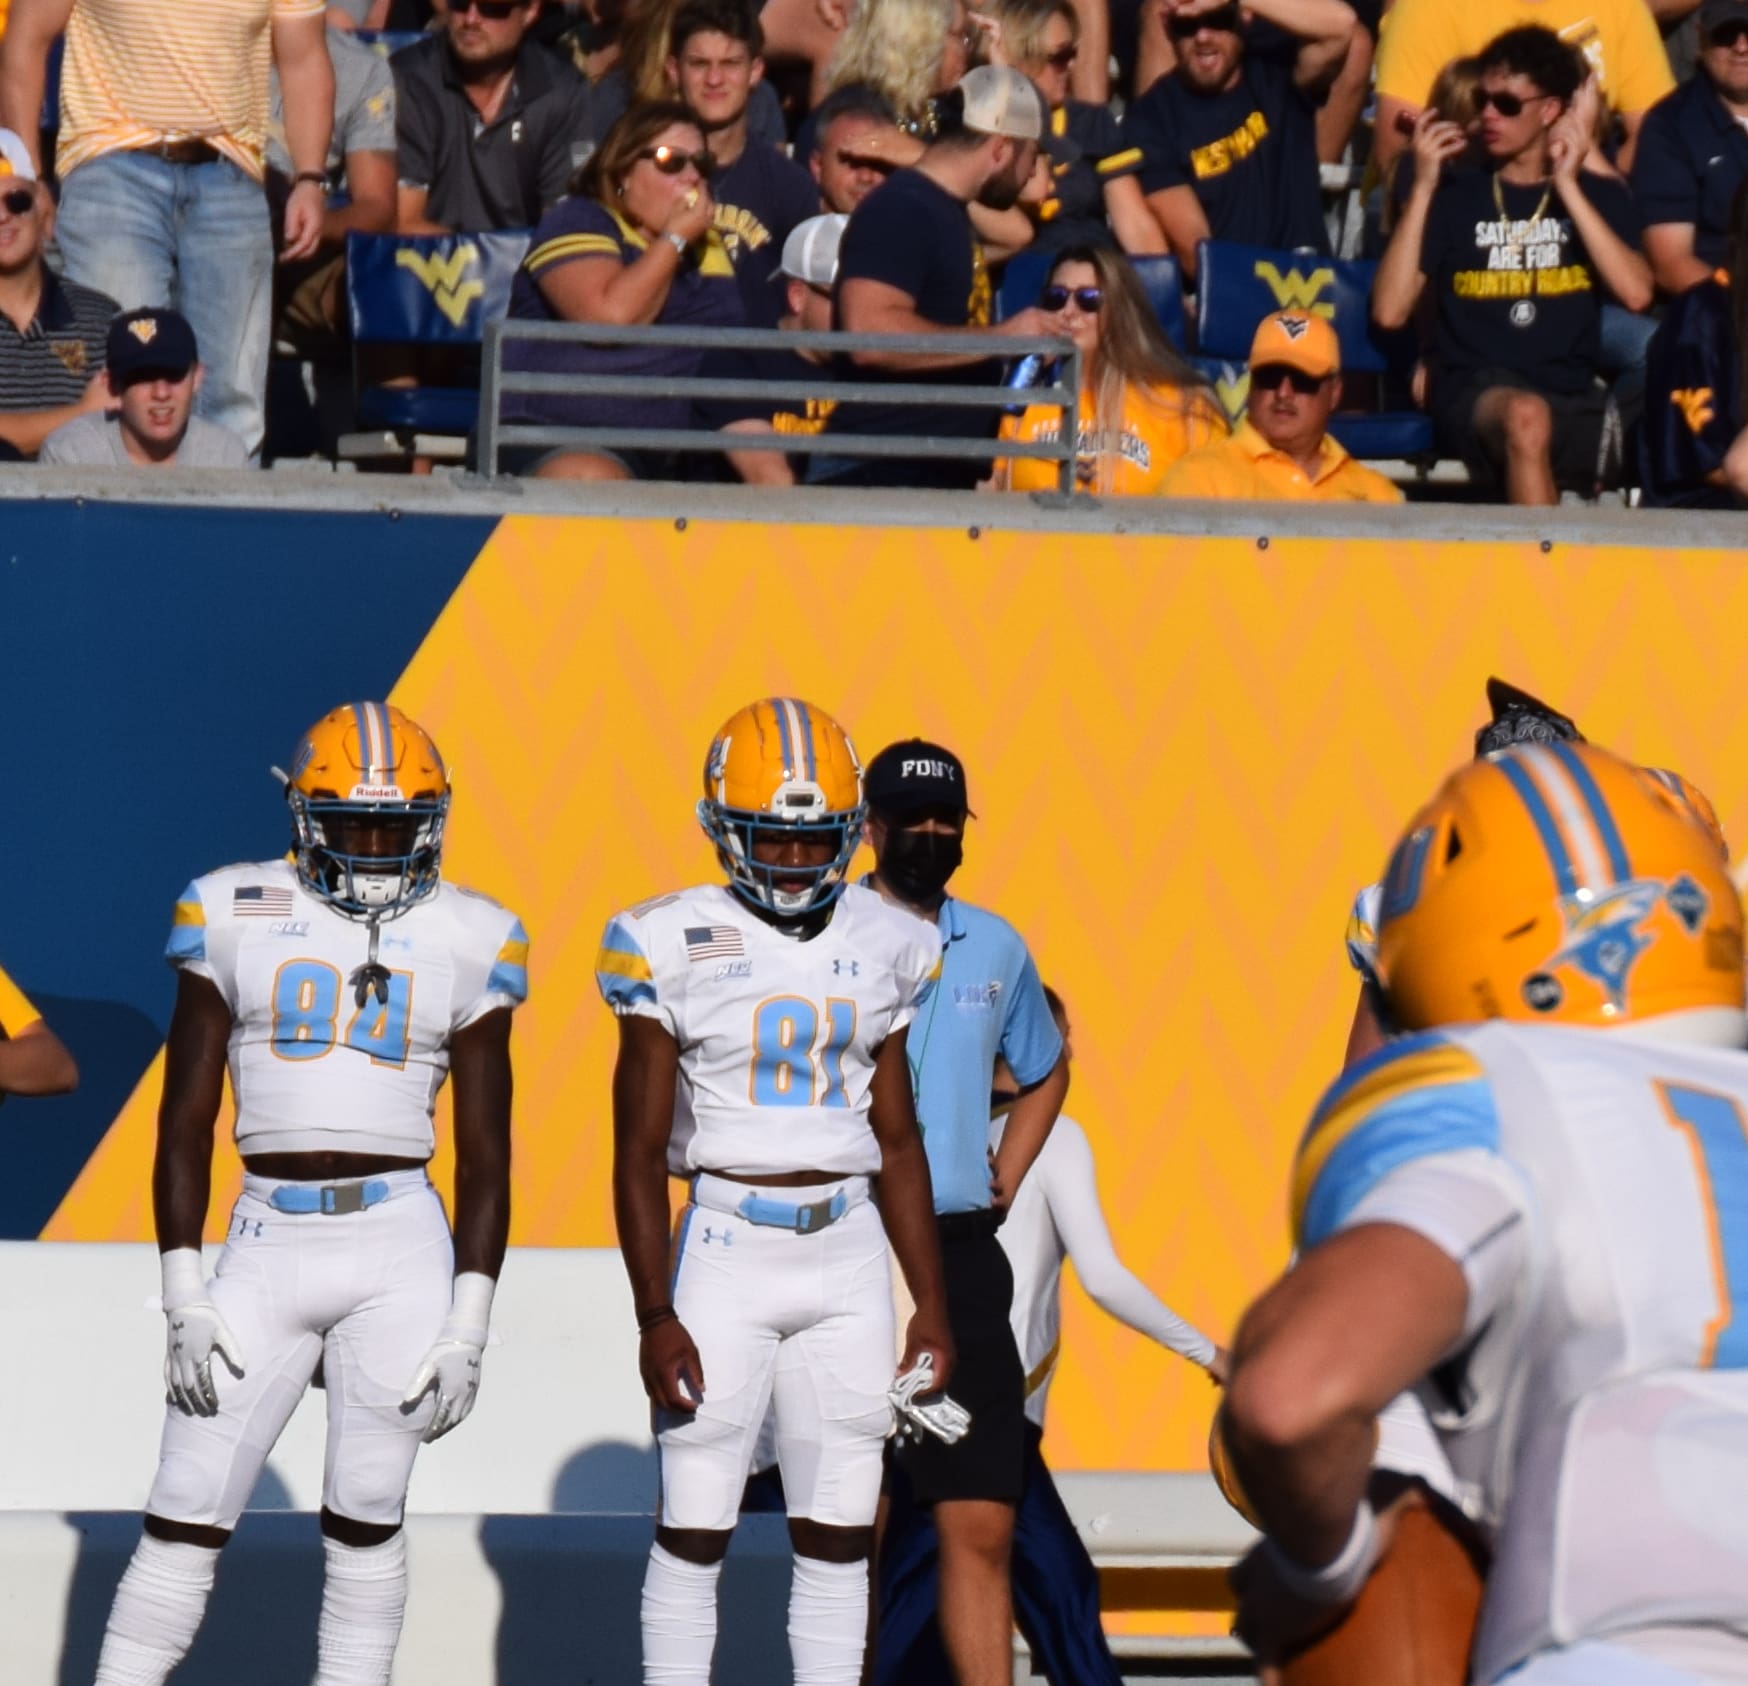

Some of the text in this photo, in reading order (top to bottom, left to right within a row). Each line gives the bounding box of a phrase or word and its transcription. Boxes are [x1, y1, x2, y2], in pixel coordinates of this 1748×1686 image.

[1487, 243, 1560, 270] ARE FOR
[1453, 269, 1532, 298] COUNTRY
[901, 758, 955, 782] FDNY
[271, 956, 416, 1071] 84
[749, 994, 858, 1109] 81
